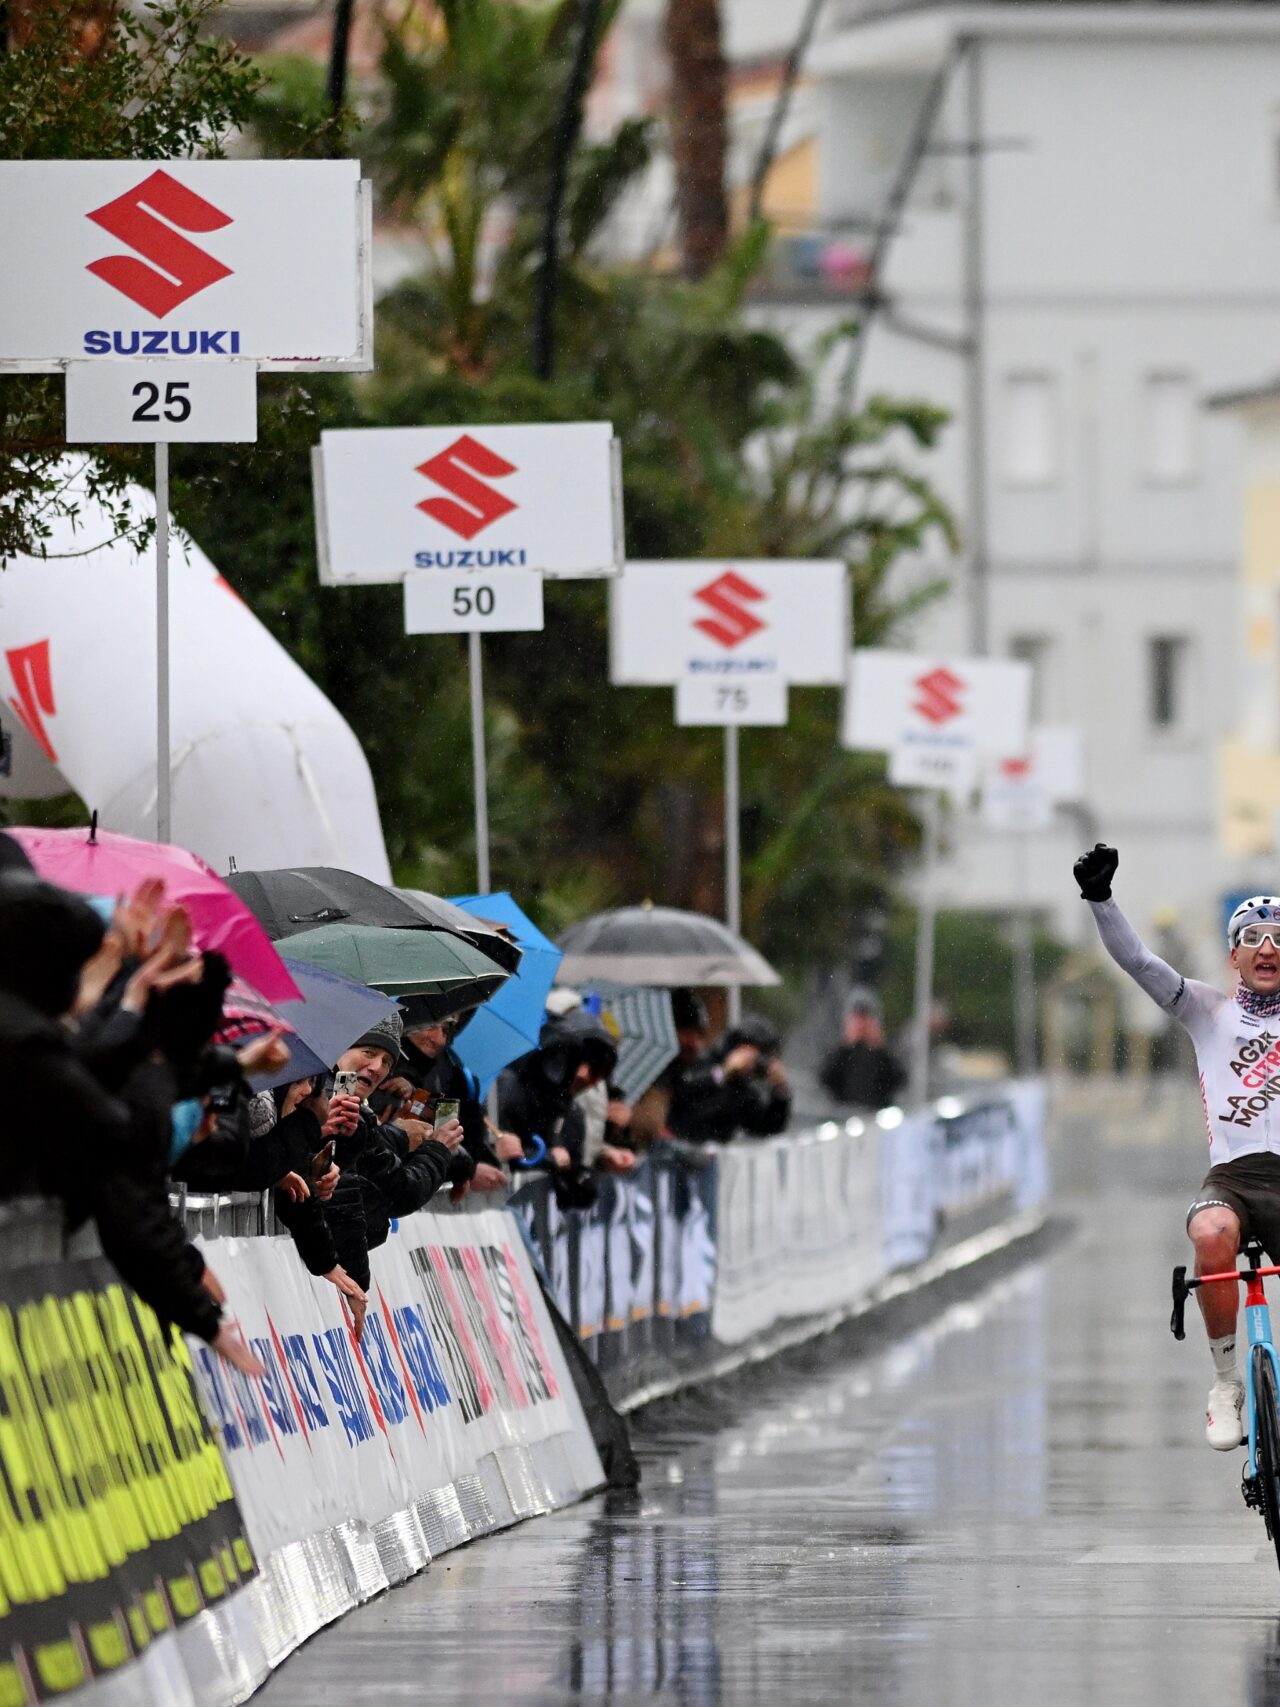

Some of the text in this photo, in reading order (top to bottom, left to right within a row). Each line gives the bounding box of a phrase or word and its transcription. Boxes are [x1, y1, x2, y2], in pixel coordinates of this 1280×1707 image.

[83, 330, 240, 355] SUZUKI
[132, 381, 191, 423] 25
[415, 549, 526, 569] SUZUKI
[453, 586, 495, 616] 50
[718, 687, 750, 713] 75
[1218, 1096, 1248, 1122] LA
